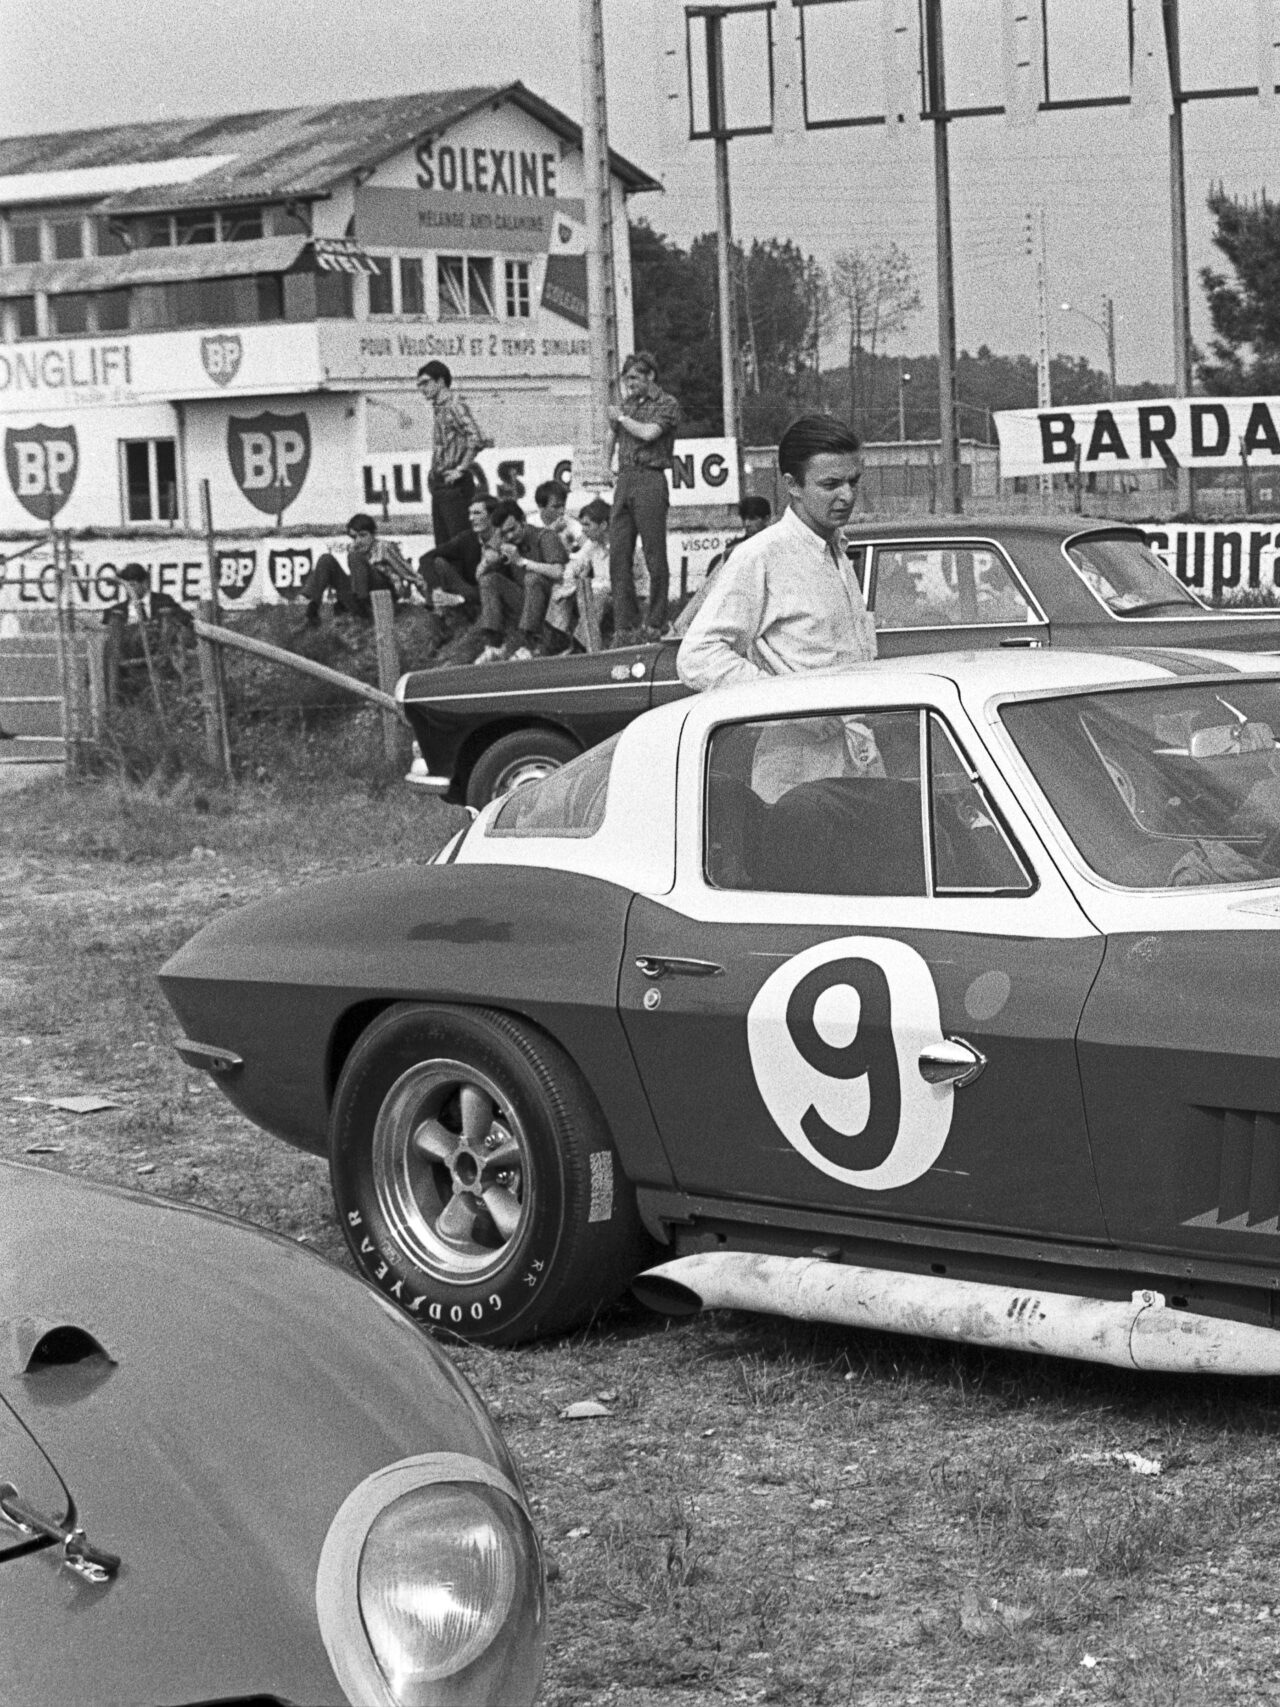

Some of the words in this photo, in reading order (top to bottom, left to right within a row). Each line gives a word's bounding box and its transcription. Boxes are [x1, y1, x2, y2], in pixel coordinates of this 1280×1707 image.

[416, 144, 557, 197] SOLEXINE
[205, 342, 241, 375] BP
[488, 334, 497, 356] 2
[14, 440, 75, 496] BP
[238, 430, 306, 489] BP
[220, 557, 254, 588] BP
[274, 556, 311, 588] BP
[785, 956, 902, 1172] 9
[348, 1209, 502, 1322] GOODYEAR
